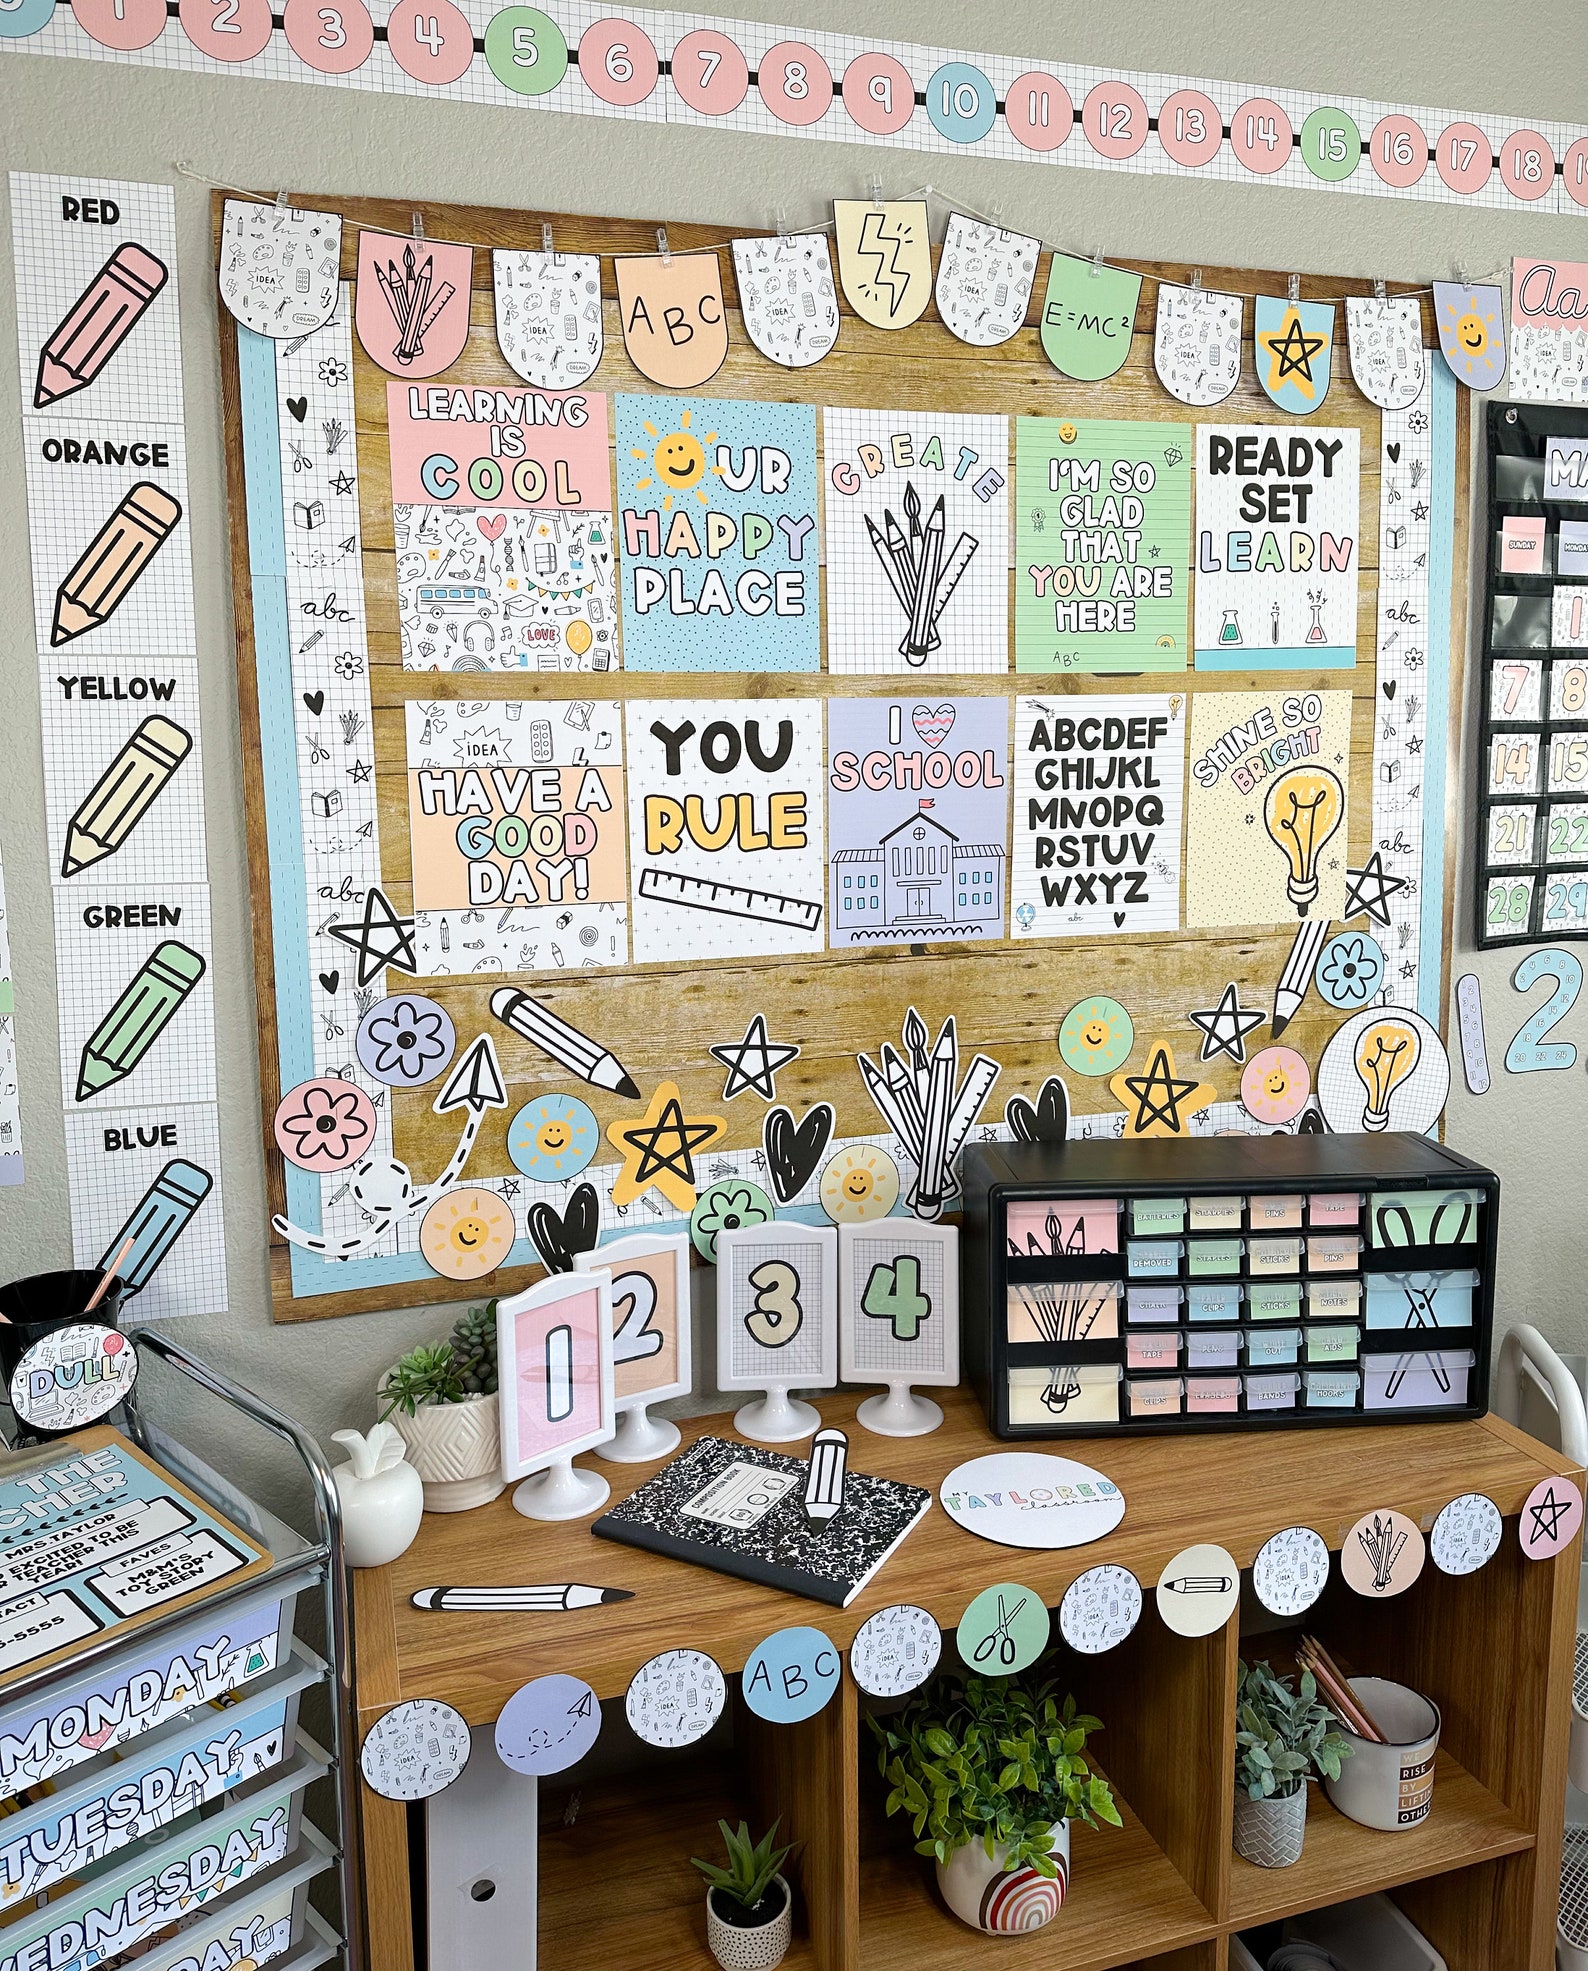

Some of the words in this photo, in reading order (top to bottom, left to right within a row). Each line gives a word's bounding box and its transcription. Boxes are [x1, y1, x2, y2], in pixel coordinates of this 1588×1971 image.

[211, 0, 243, 34] 2
[317, 8, 348, 49] 3
[414, 14, 446, 58] 4
[511, 26, 540, 68] 5
[604, 43, 634, 83] 6
[698, 51, 723, 89] 7
[783, 61, 809, 100] 8
[868, 75, 893, 115] 9
[942, 80, 980, 119] 10
[1029, 90, 1050, 128] 11
[1099, 102, 1133, 140] 12
[1175, 107, 1206, 144] 13
[1246, 115, 1280, 152] 14
[1317, 126, 1348, 163] 15
[1382, 130, 1414, 166] 16
[1449, 138, 1479, 172] 17
[1513, 148, 1543, 183] 18
[62, 195, 120, 225] RED
[255, 275, 277, 286] IDEA
[529, 326, 548, 335] IDEA
[771, 307, 789, 317] IDEA
[1180, 350, 1196, 359] IDEA
[408, 387, 589, 428] LEARNING
[42, 438, 170, 467] ORANGE
[489, 425, 526, 459] IS
[1209, 435, 1344, 478] READY
[420, 453, 582, 505] COOL
[831, 433, 1005, 504] CREATE
[1049, 458, 1102, 493] I'M
[1109, 460, 1157, 494] SO
[1060, 495, 1145, 529] GLAD
[1239, 482, 1313, 524] SET
[622, 508, 816, 562] HAPPY
[1061, 530, 1143, 564] THAT
[1199, 531, 1353, 573] LEARN
[1508, 540, 1537, 550] SUNDAY
[633, 566, 806, 617] PLACE
[1028, 565, 1101, 598] YOU
[1110, 566, 1173, 598] ARE
[300, 592, 356, 623] abc
[1055, 599, 1137, 634] HERE
[1385, 600, 1421, 624] abc
[1569, 595, 1584, 640] 1
[526, 628, 557, 642] LOVE
[57, 675, 177, 701] YELLOW
[1501, 665, 1530, 715] 7
[1562, 667, 1588, 712] 8
[888, 705, 903, 746] I
[1028, 717, 1168, 752] ABCDEF
[1193, 706, 1278, 788] SHINE
[1282, 693, 1323, 728] SO
[649, 719, 794, 777] YOU
[1230, 725, 1322, 796] BRIGHT
[1493, 743, 1531, 784] 14
[1551, 742, 1588, 784] 15
[830, 749, 1005, 792] SCHOOL
[1034, 756, 1161, 791] GHIJKL
[417, 767, 562, 816] HAVE
[575, 767, 613, 813] A
[644, 790, 808, 856] RULE
[1028, 794, 1165, 831] MNOPQ
[455, 813, 599, 860] GOOD
[1035, 832, 1156, 870] RSTUV
[1379, 830, 1415, 855] abc
[1494, 814, 1528, 853] 21
[467, 856, 590, 906] DAY!
[1040, 871, 1150, 908] WXYZ
[83, 904, 182, 929] GREEN
[1488, 883, 1531, 924] 28
[1547, 882, 1588, 920] 29
[1503, 947, 1584, 1074] 2
[103, 1124, 177, 1152] BLUE
[1136, 1210, 1181, 1223] BATTERIES
[1132, 1258, 1173, 1268] REMOVER
[1259, 1254, 1291, 1264] STICKS
[1323, 1253, 1345, 1263] PINS
[744, 1259, 804, 1349] 3
[860, 1254, 932, 1342] 4
[1202, 1303, 1226, 1313] CLIPS
[1260, 1301, 1291, 1312] STICKS
[1320, 1298, 1349, 1308] NOTES
[611, 1271, 664, 1365] 2
[544, 1323, 575, 1424] 1
[1142, 1350, 1164, 1360] TAPE
[28, 1354, 121, 1400] DULL
[1316, 1388, 1346, 1399] HOOKS
[15, 1449, 123, 1495] THE
[691, 1476, 729, 1509] COMPOSITION
[723, 1468, 742, 1482] BOOK
[8, 1542, 86, 1575] EXCITED
[88, 1531, 112, 1544] TO
[115, 1519, 140, 1533] BE
[12, 1546, 96, 1582] TEACHER
[98, 1528, 140, 1548] THIS
[119, 1543, 172, 1568] FAVES
[26, 1560, 84, 1584] YEAR!
[115, 1578, 152, 1598] TOY
[158, 1550, 215, 1581] STORY
[127, 1552, 193, 1584] M&M'S
[145, 1566, 206, 1595] GREEN
[747, 1650, 837, 1700] ABC
[0, 1635, 231, 1778] MONDAY
[1402, 1763, 1427, 1779] RISE
[1402, 1782, 1417, 1793] BY
[0, 1730, 242, 1885] TUESDAY
